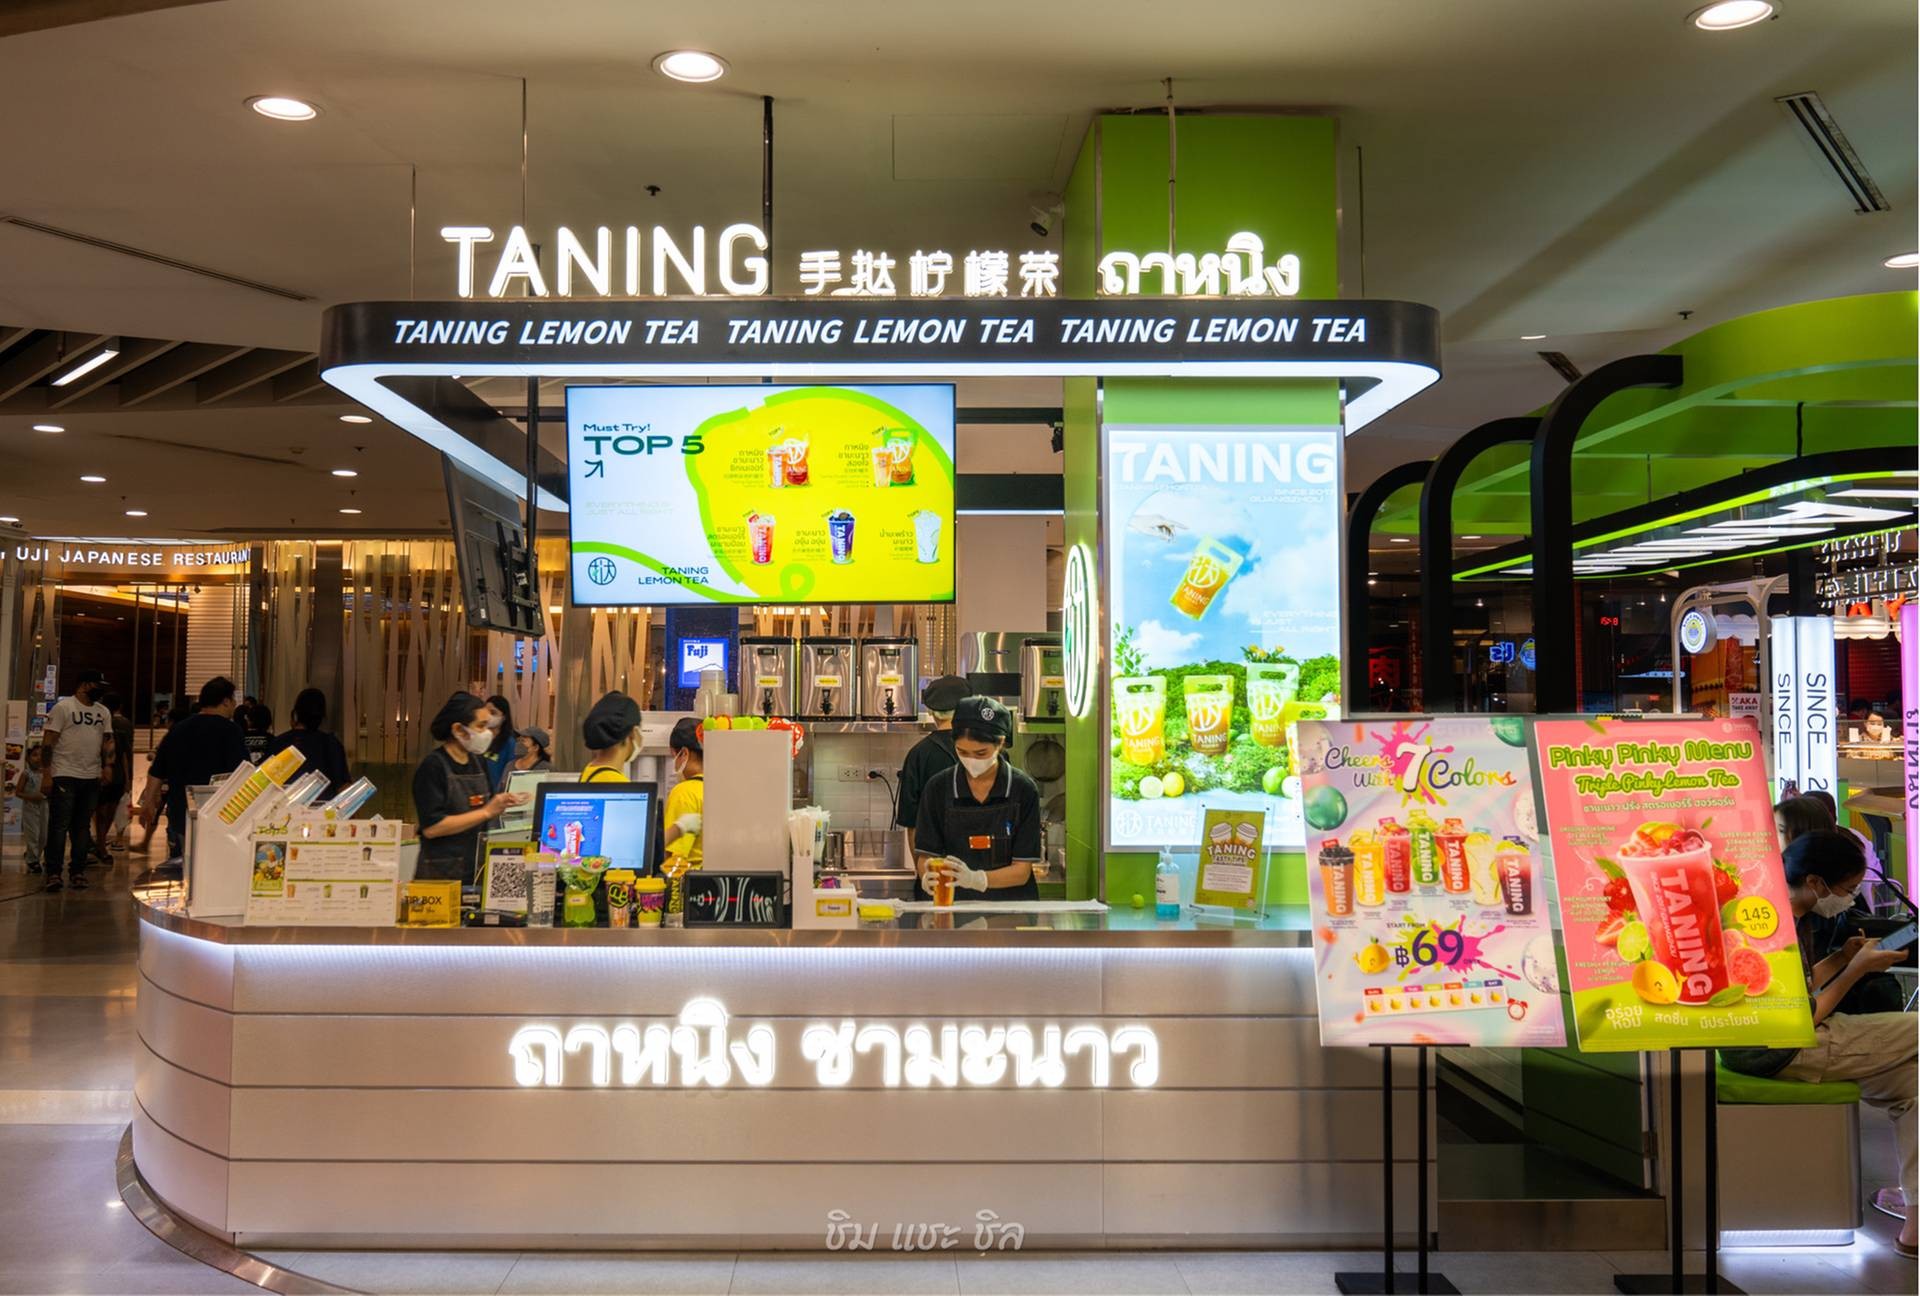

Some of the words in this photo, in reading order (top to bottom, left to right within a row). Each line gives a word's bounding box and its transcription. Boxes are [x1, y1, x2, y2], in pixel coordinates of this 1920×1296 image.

[440, 223, 769, 297] TANING
[1097, 231, 1301, 297] ถาหนิง
[394, 319, 508, 344] TANING
[519, 319, 632, 345] LEMON
[644, 319, 700, 345] TEA
[727, 318, 842, 344] TANING
[853, 318, 966, 344] LEMON
[979, 318, 1035, 344] TEA
[1060, 317, 1177, 344] TANING
[1185, 317, 1299, 344] LEMON
[1310, 317, 1366, 344] TEA
[584, 424, 620, 432] Must
[622, 423, 651, 434] Try!
[584, 435, 673, 456] TOP
[681, 435, 705, 455] 5
[1111, 442, 1335, 484] TANING
[61, 550, 162, 566] JAPANESE
[662, 567, 709, 575] TANING
[638, 577, 682, 585] LEMON
[687, 644, 708, 658] Fuji
[72, 711, 105, 726] USA
[1325, 746, 1395, 770] Cheers
[1353, 769, 1394, 788] With
[1396, 742, 1433, 793] 7
[1428, 758, 1517, 790] Colors
[1550, 744, 1614, 769] Pinky
[1617, 742, 1680, 766] Pinky
[1684, 740, 1752, 761] Menu
[1575, 772, 1620, 798] Triple
[1620, 771, 1665, 798] Pinky
[1664, 771, 1707, 789] Lemon
[1709, 768, 1740, 787] Tea
[1208, 844, 1256, 859] TANING
[1418, 832, 1434, 882] TANING
[1448, 840, 1464, 889] TANING
[1389, 840, 1405, 890] TANING
[1333, 863, 1346, 913] TANING
[1505, 859, 1524, 912] TANING
[422, 896, 442, 905] BOX
[1743, 906, 1771, 922] 145
[1660, 868, 1713, 996] TANING
[1605, 1003, 1643, 1020] อร่อย
[1612, 1015, 1641, 1030] หอม
[509, 997, 776, 1088] ถาหนิง
[800, 1020, 1161, 1088] ชามะนาว
